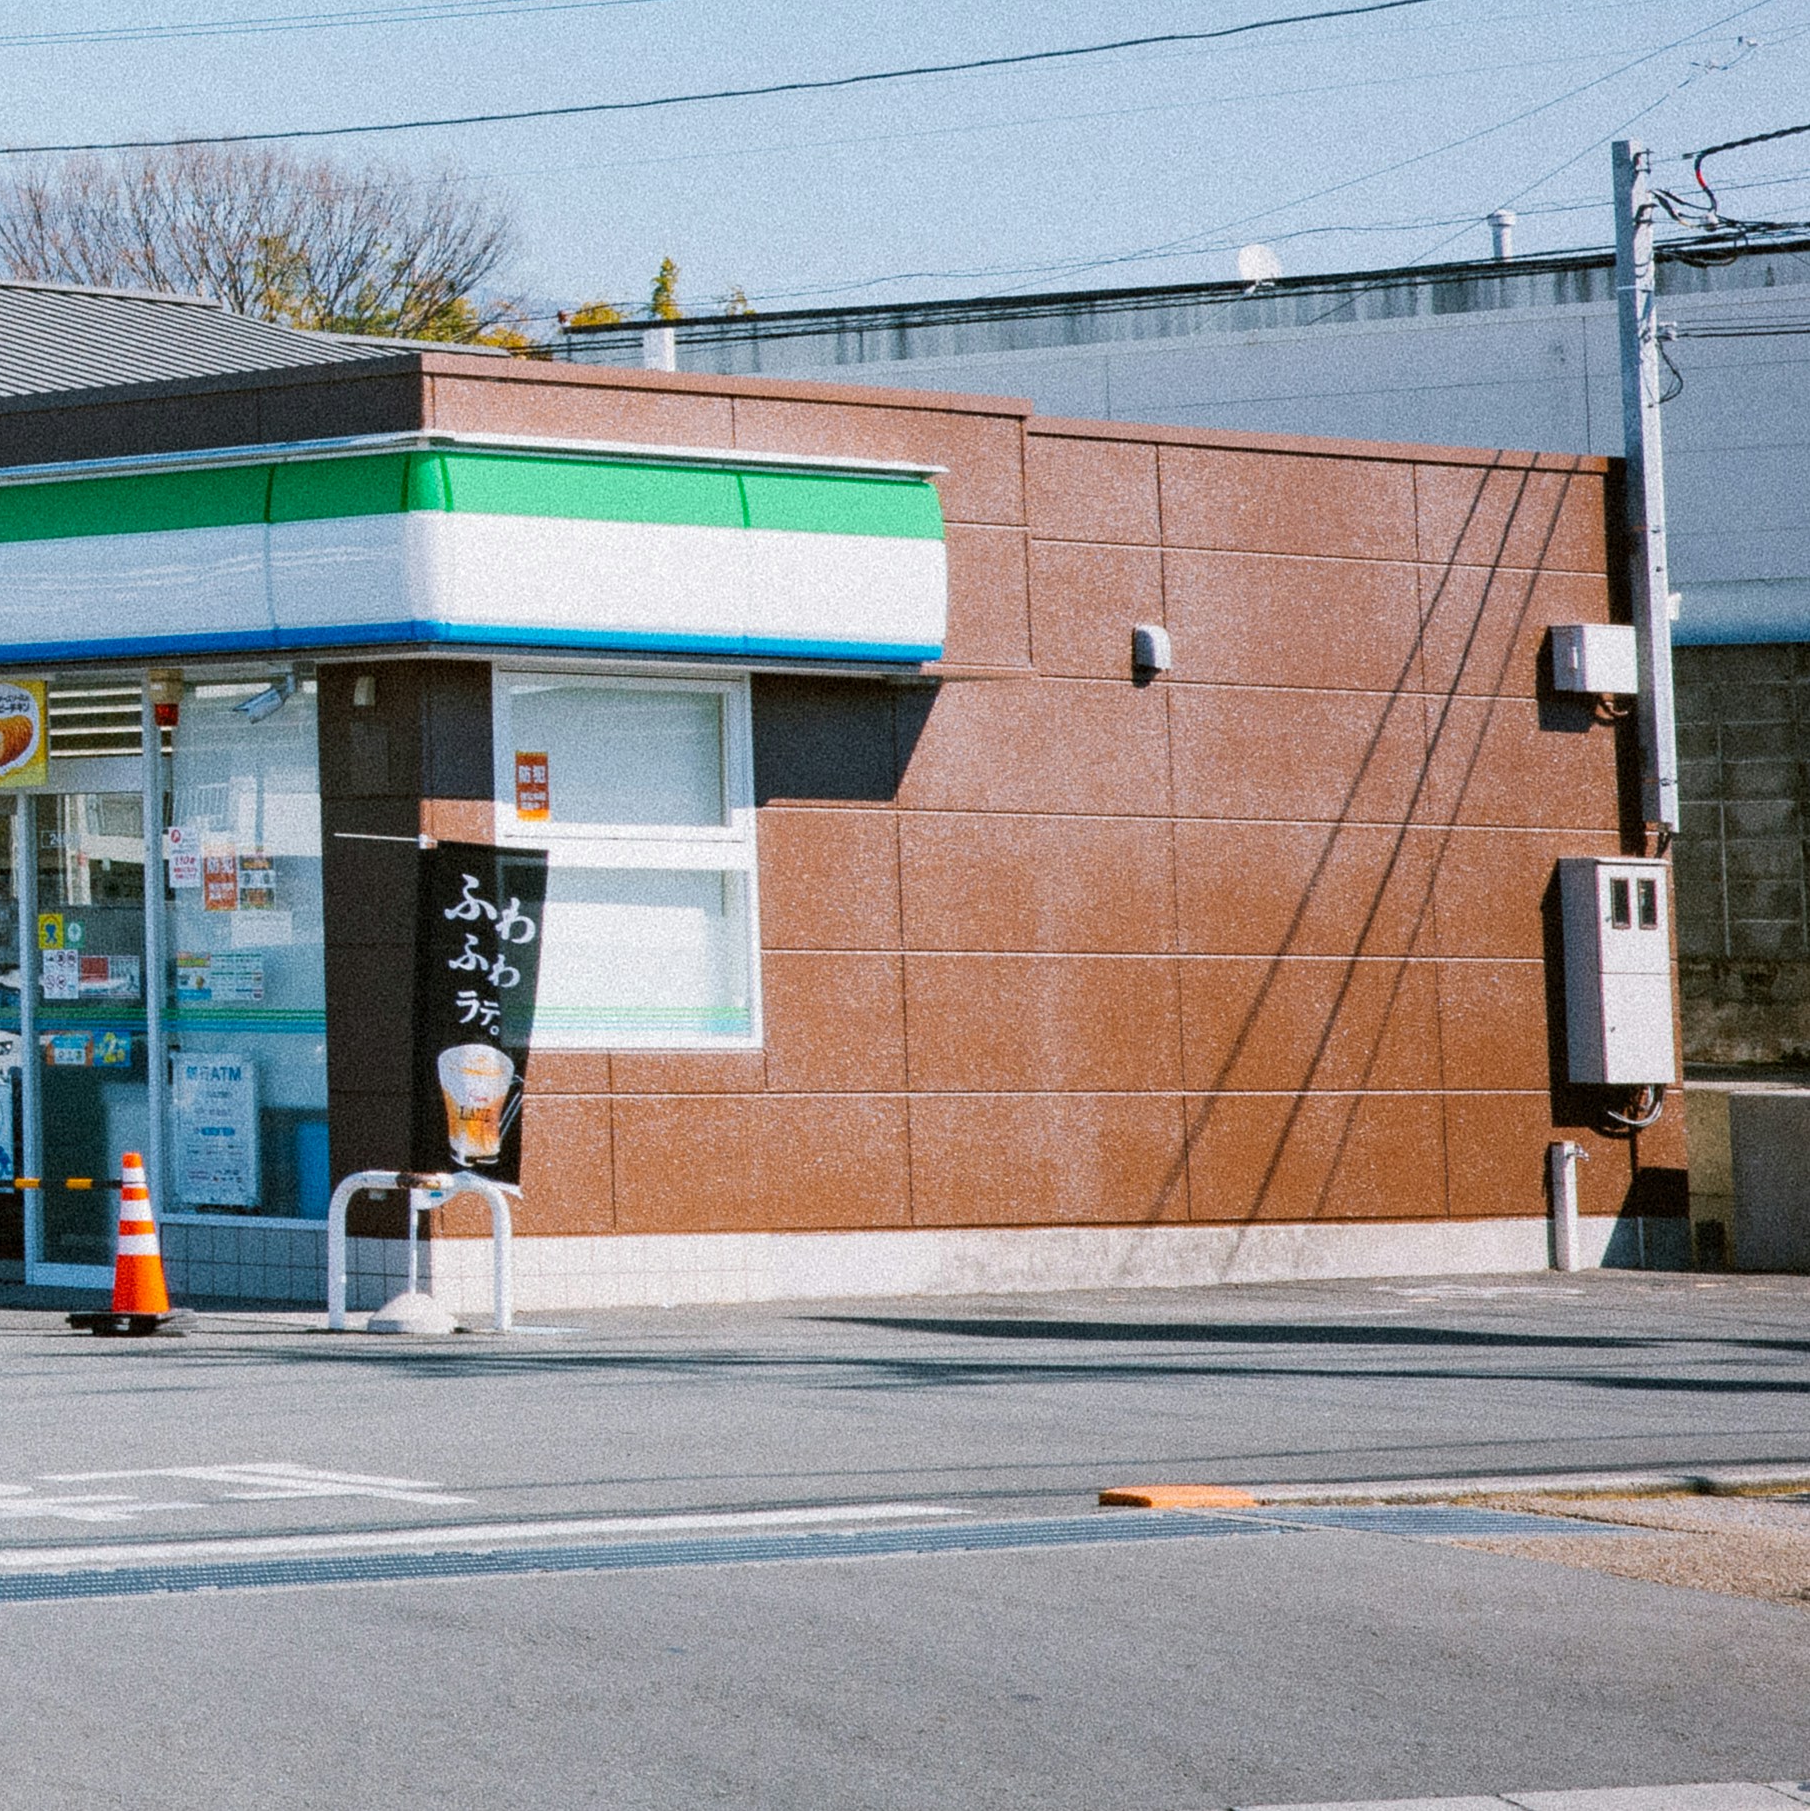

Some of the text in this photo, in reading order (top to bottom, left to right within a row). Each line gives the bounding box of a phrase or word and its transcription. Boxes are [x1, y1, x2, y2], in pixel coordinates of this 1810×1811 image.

[444, 873, 536, 944] ふわ
[448, 933, 521, 989] ふわ
[456, 991, 501, 1036] ラテ。
